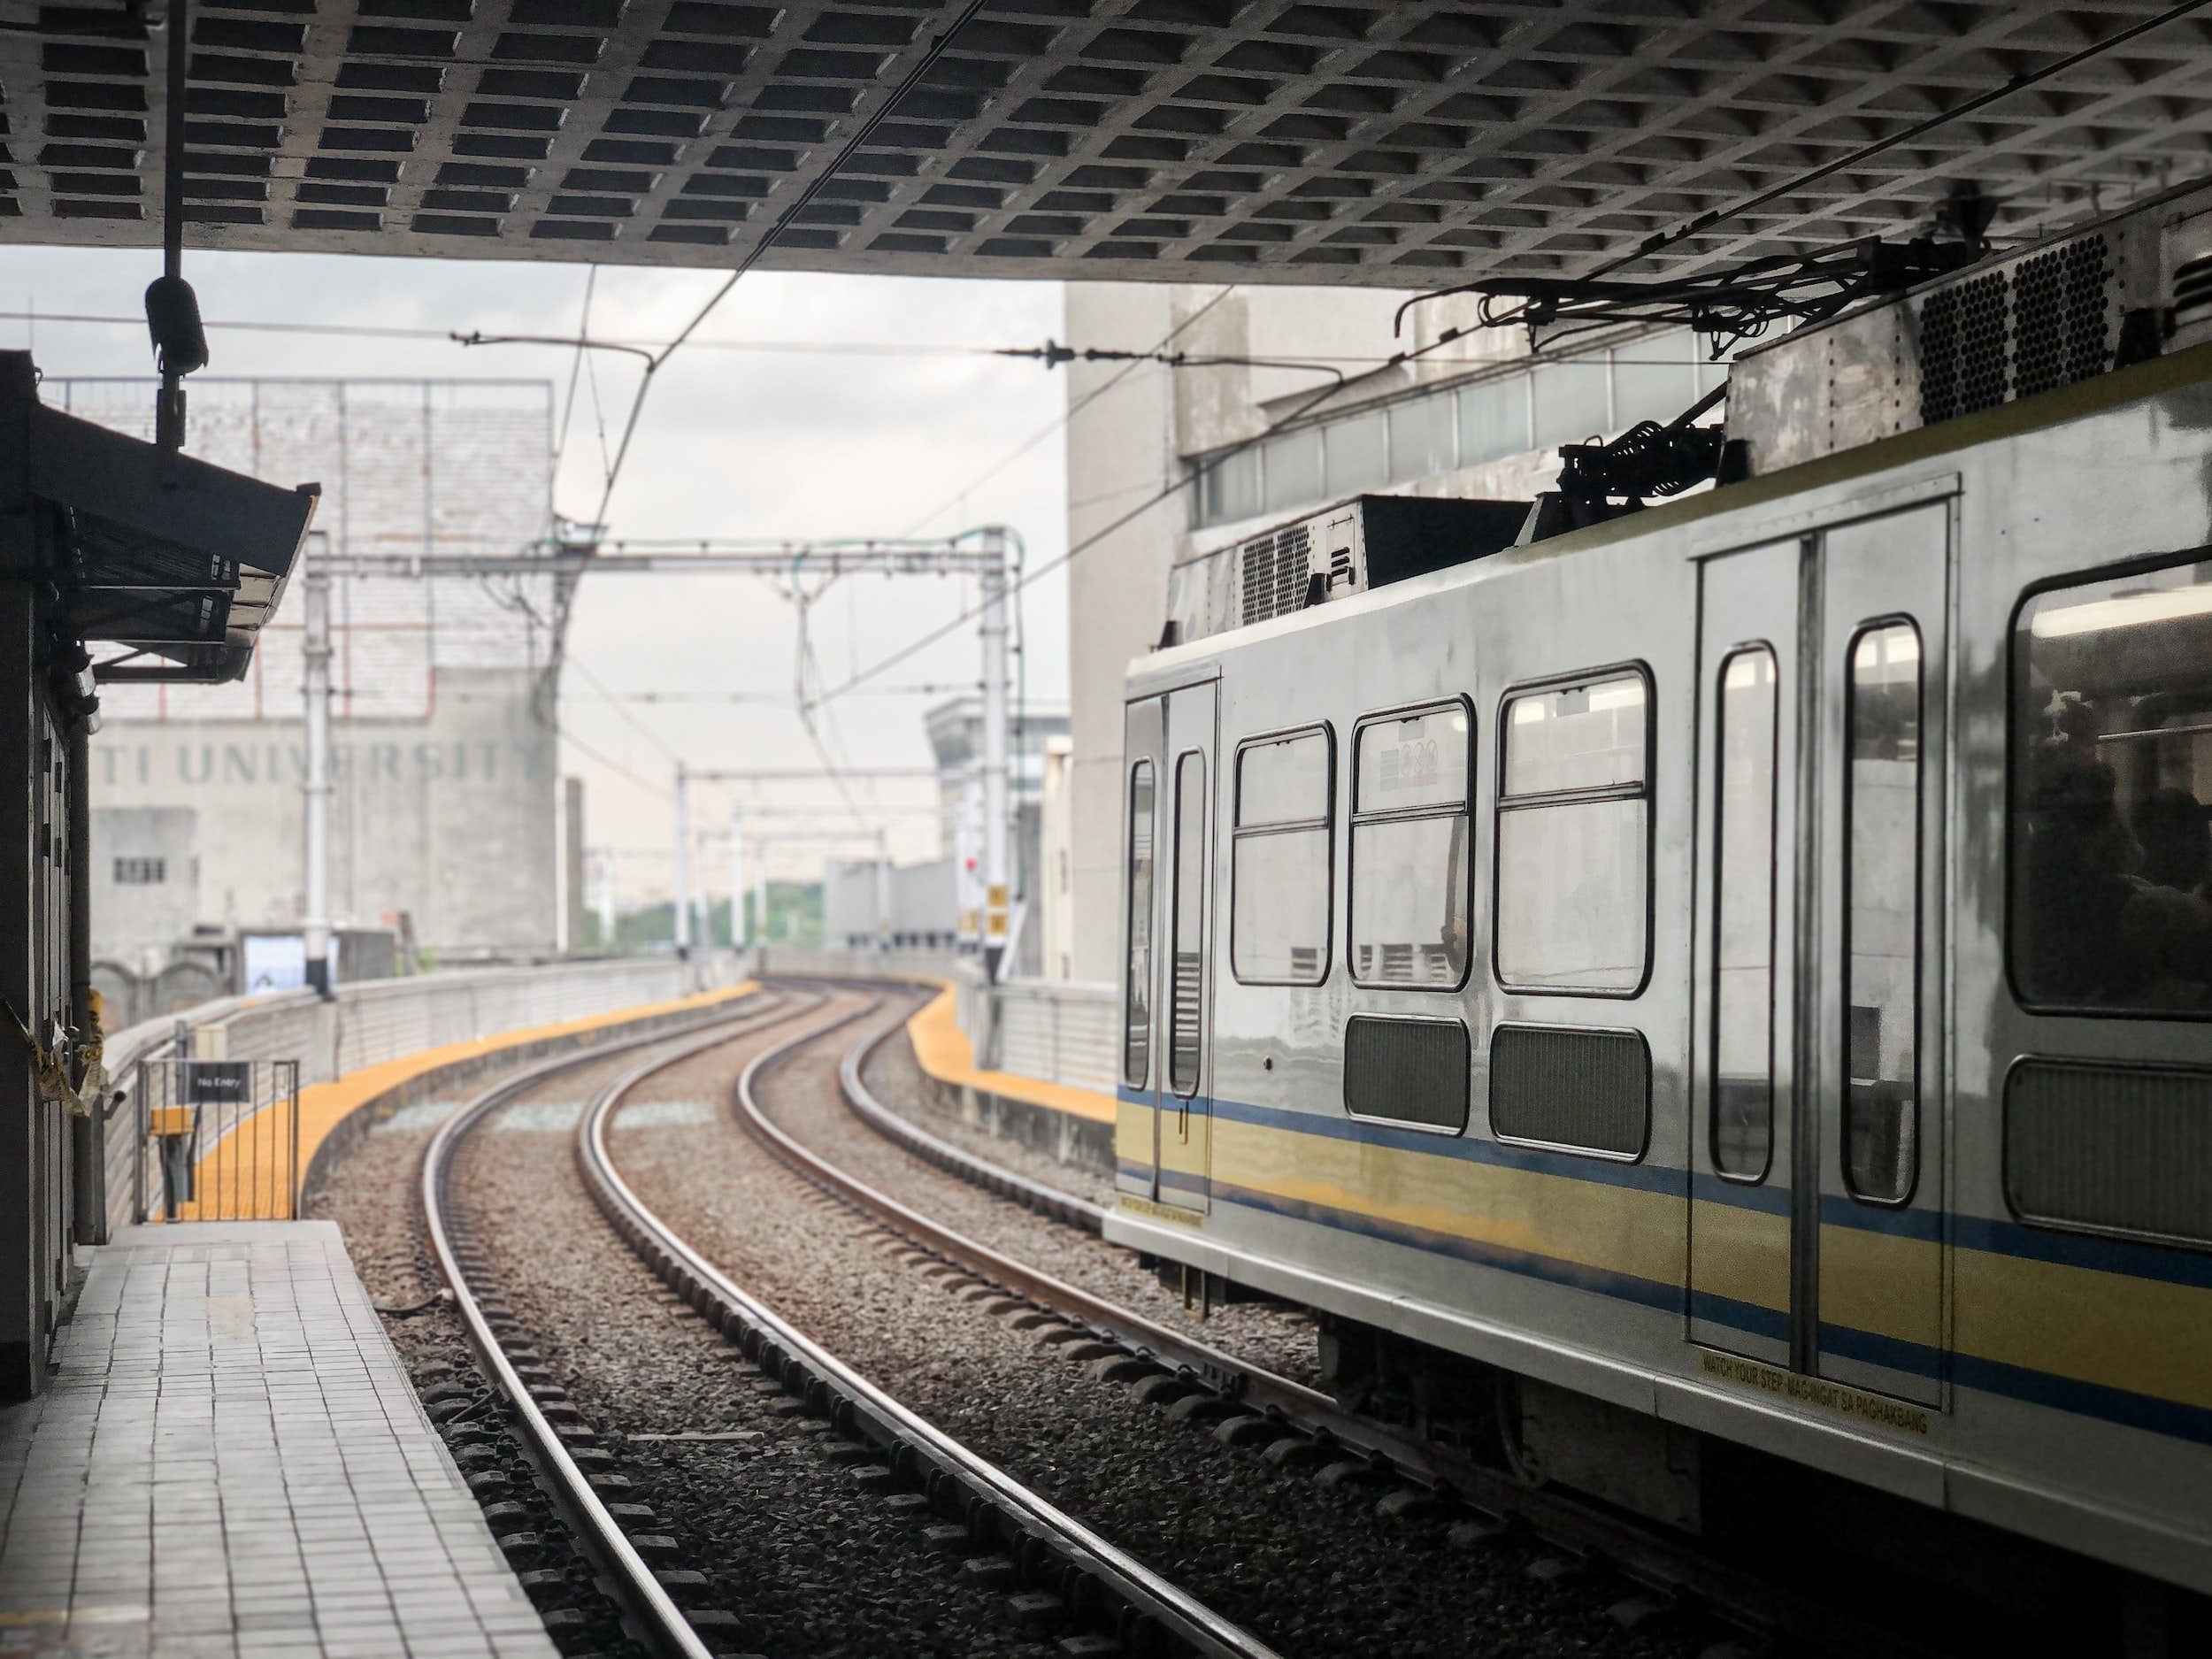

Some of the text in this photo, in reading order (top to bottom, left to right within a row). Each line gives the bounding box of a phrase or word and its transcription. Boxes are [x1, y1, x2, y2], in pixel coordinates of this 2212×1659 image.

[178, 742, 545, 785] UNIVERSITY
[197, 1077, 241, 1089] No Entry
[1703, 1354, 1732, 1378] WATCH
[1732, 1363, 1758, 1386] YOUR
[1760, 1369, 1783, 1392] STEP
[1840, 1392, 1854, 1411] SA
